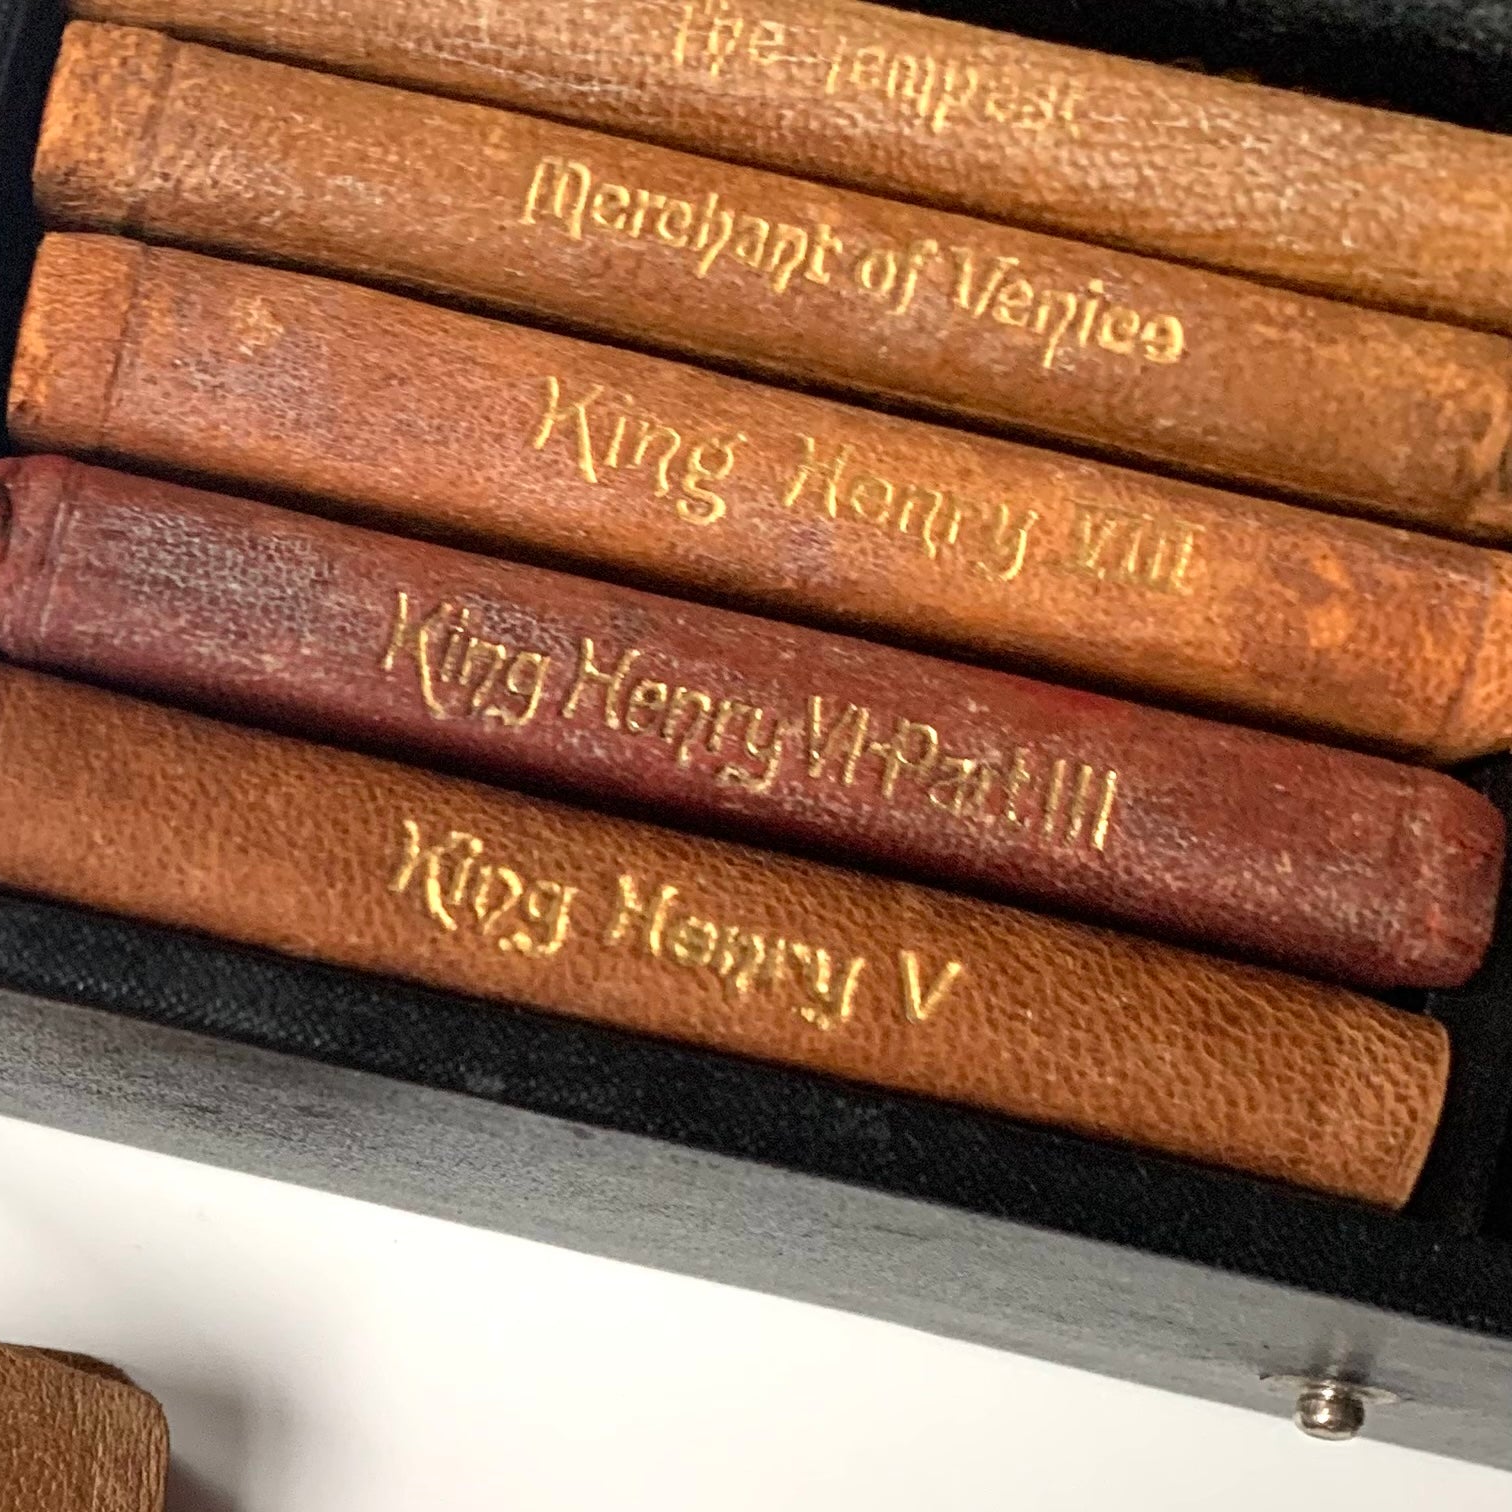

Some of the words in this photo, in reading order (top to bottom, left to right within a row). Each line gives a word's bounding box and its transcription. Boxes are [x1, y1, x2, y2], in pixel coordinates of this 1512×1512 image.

[520, 155, 843, 293] Merchant
[858, 237, 938, 316] of
[954, 242, 1187, 368] Venice
[532, 375, 746, 525] King
[785, 431, 1040, 582] Henry
[384, 592, 549, 727] King
[563, 637, 794, 794] Henry
[1043, 758, 1119, 851] III
[385, 819, 580, 958] King
[609, 874, 868, 1032] Henry
[898, 949, 966, 1026] V
